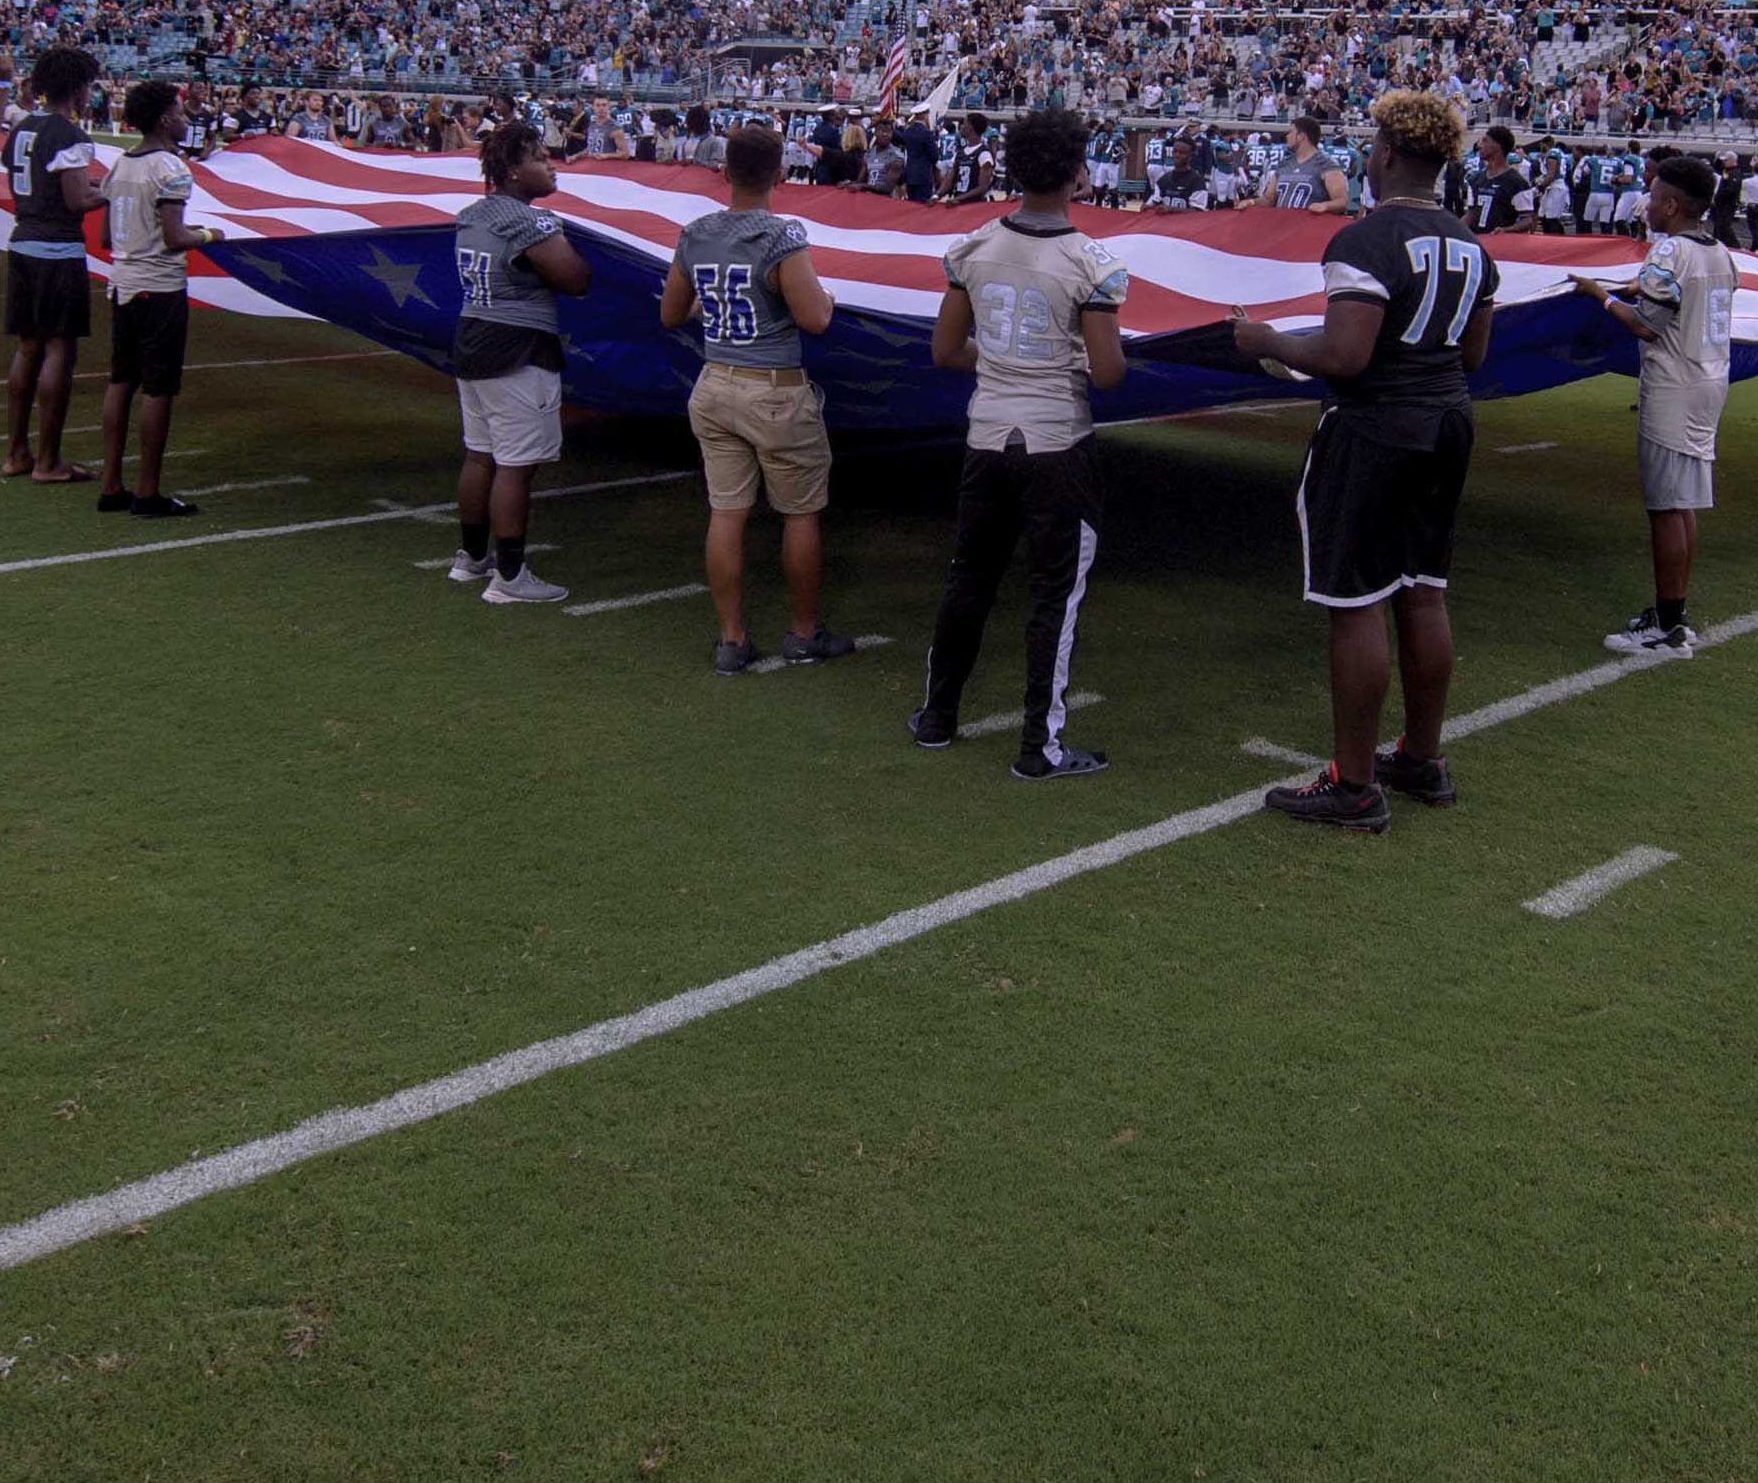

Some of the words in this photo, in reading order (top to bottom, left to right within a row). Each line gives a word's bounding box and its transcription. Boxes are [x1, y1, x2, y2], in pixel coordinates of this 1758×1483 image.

[12, 130, 37, 197] 5
[1600, 166, 1614, 184] 6
[1477, 195, 1493, 228] 7
[693, 263, 755, 345] 56
[980, 282, 1054, 360] 32
[1405, 237, 1483, 346] 77
